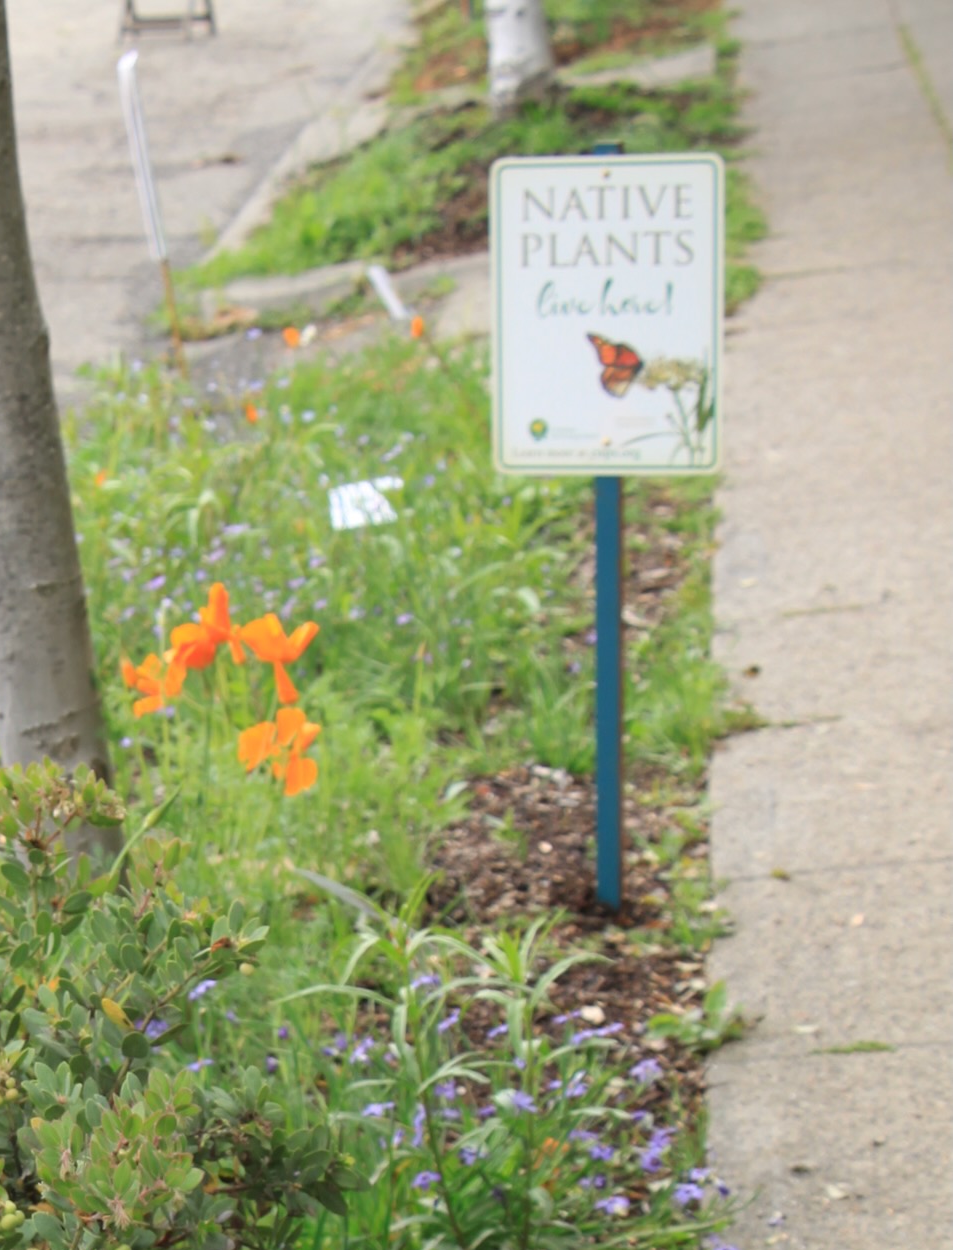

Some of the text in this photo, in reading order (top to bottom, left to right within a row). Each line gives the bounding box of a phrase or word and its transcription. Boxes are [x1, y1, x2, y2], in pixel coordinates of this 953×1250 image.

[521, 184, 694, 222] NATIVE
[520, 229, 695, 268] PLANTS
[536, 276, 675, 319] live here!
